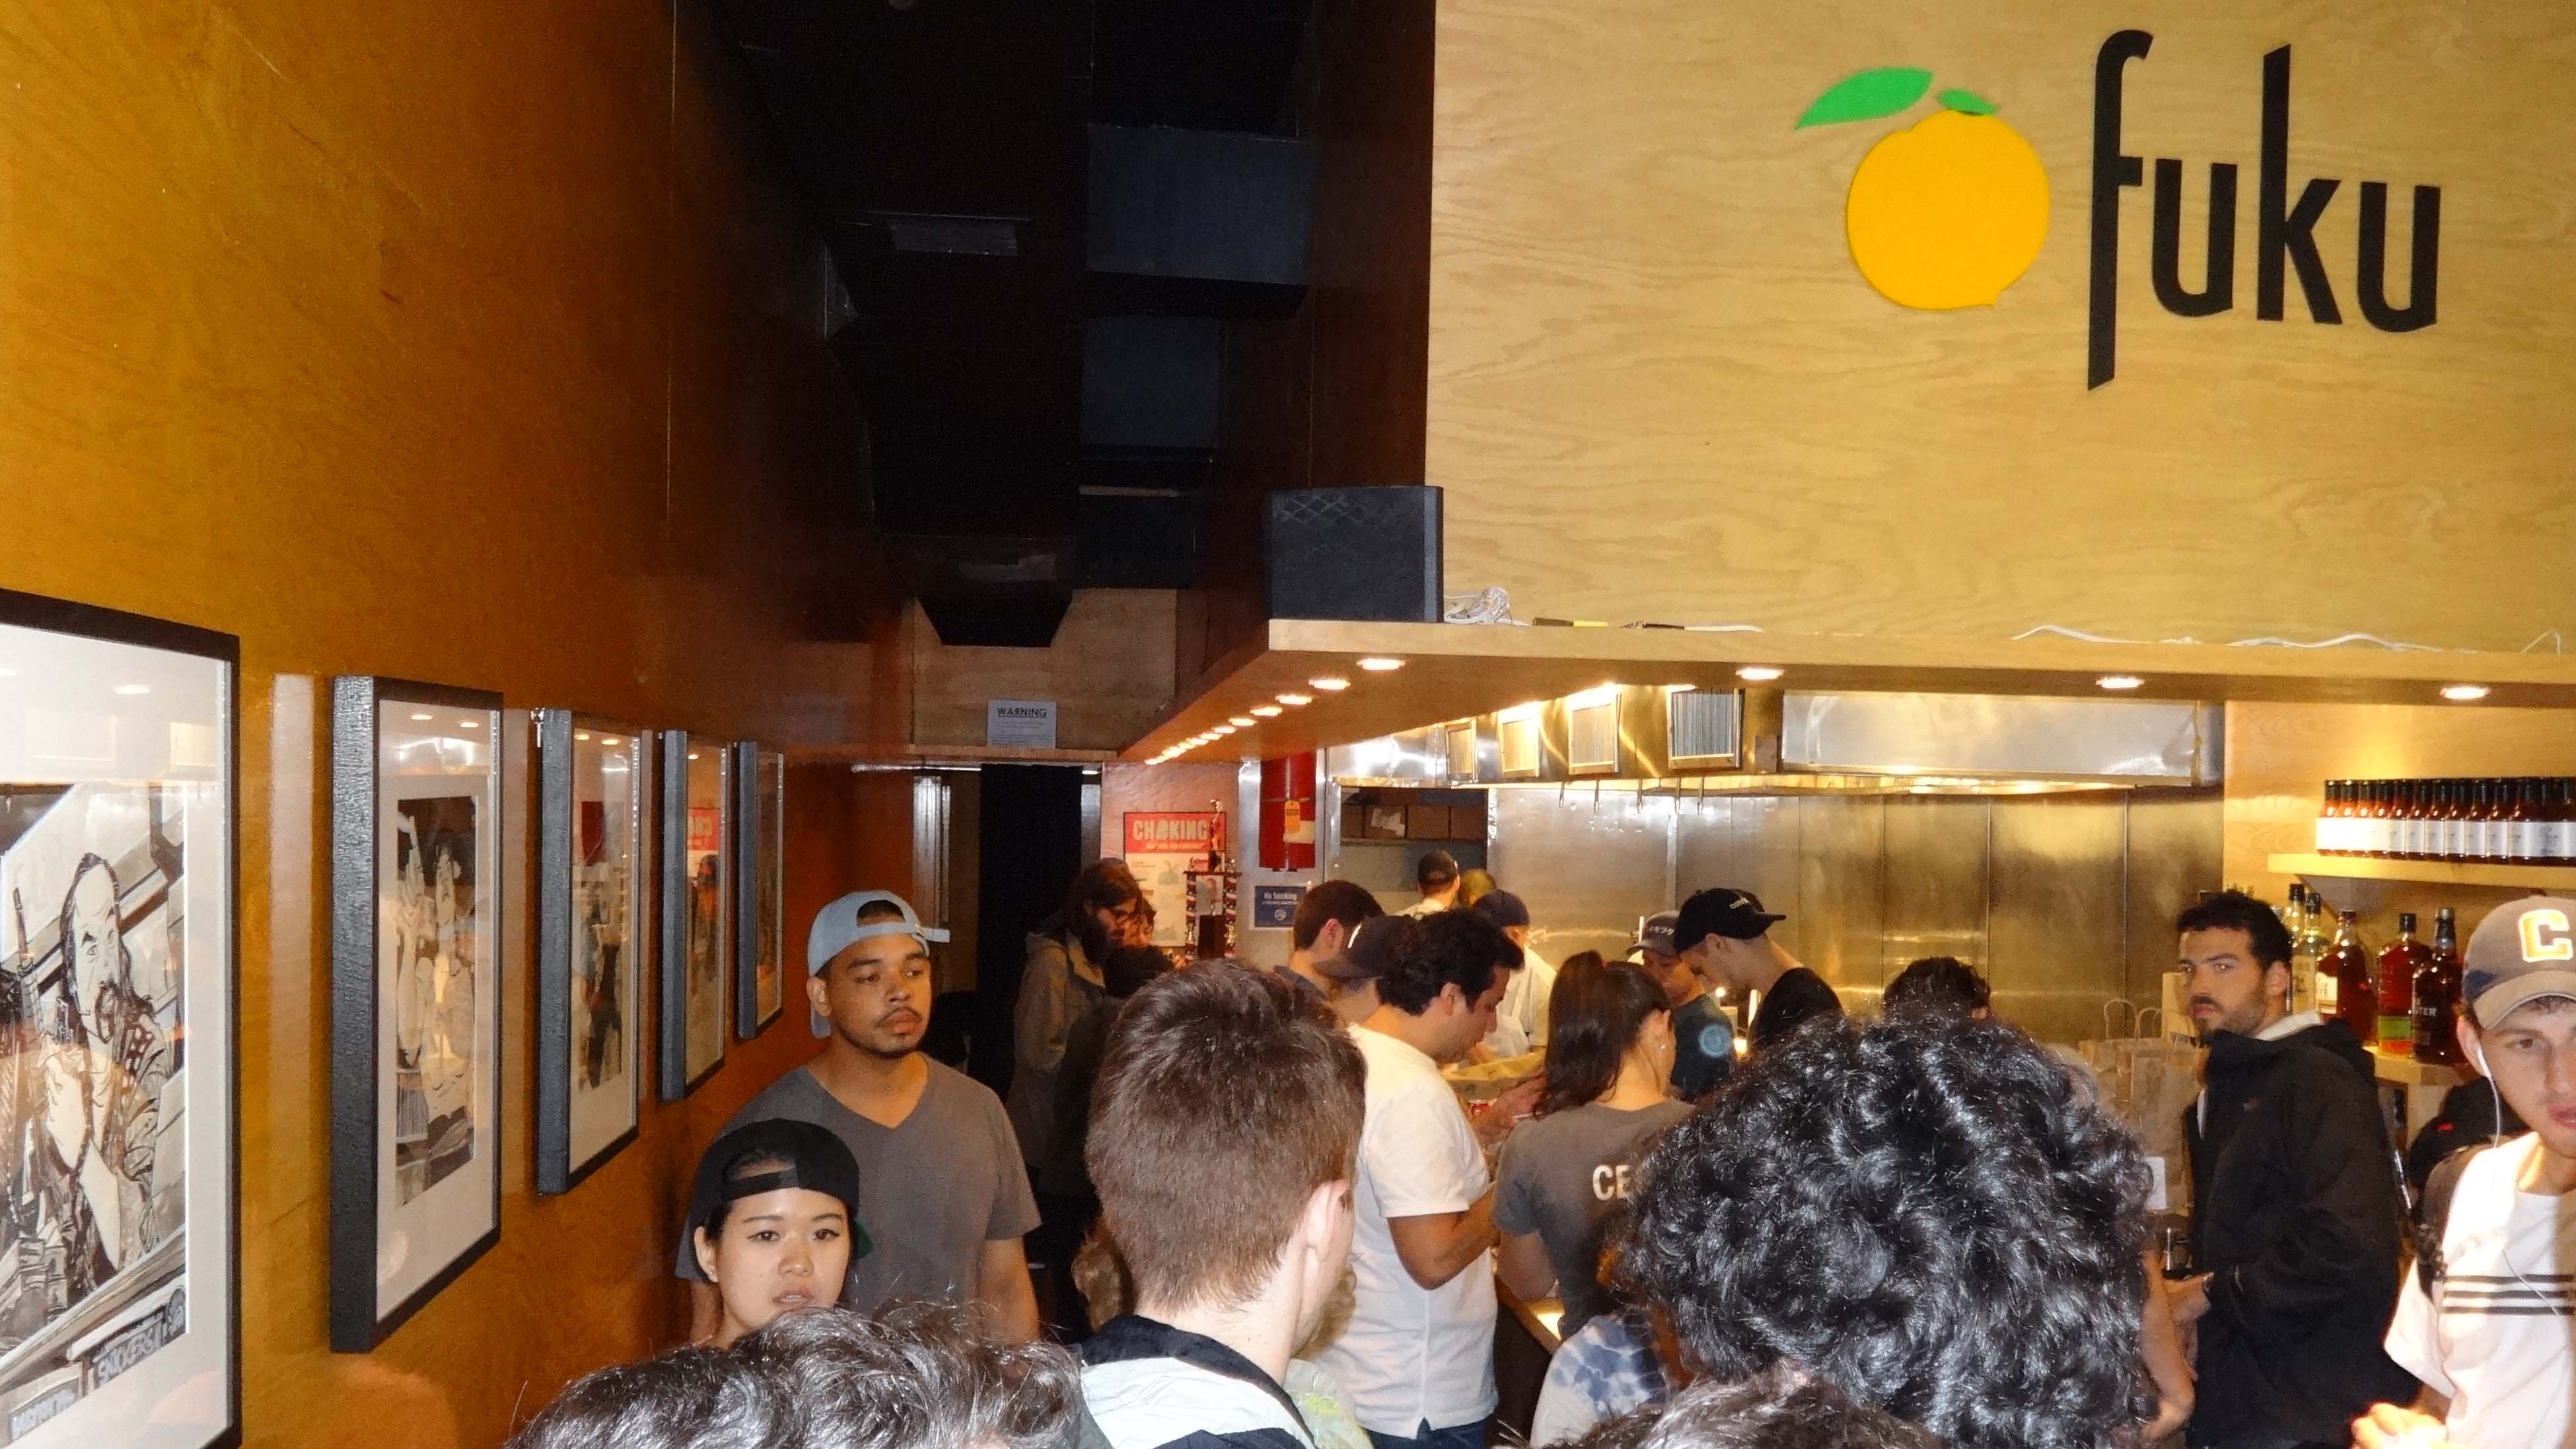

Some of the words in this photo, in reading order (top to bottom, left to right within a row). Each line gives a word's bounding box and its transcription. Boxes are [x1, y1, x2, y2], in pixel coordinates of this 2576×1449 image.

[2088, 30, 2441, 391] fuku
[997, 707, 1047, 717] WARNING
[1133, 819, 1208, 840] CHOKING
[1273, 892, 1297, 901] Smoking
[2519, 909, 2573, 963] C
